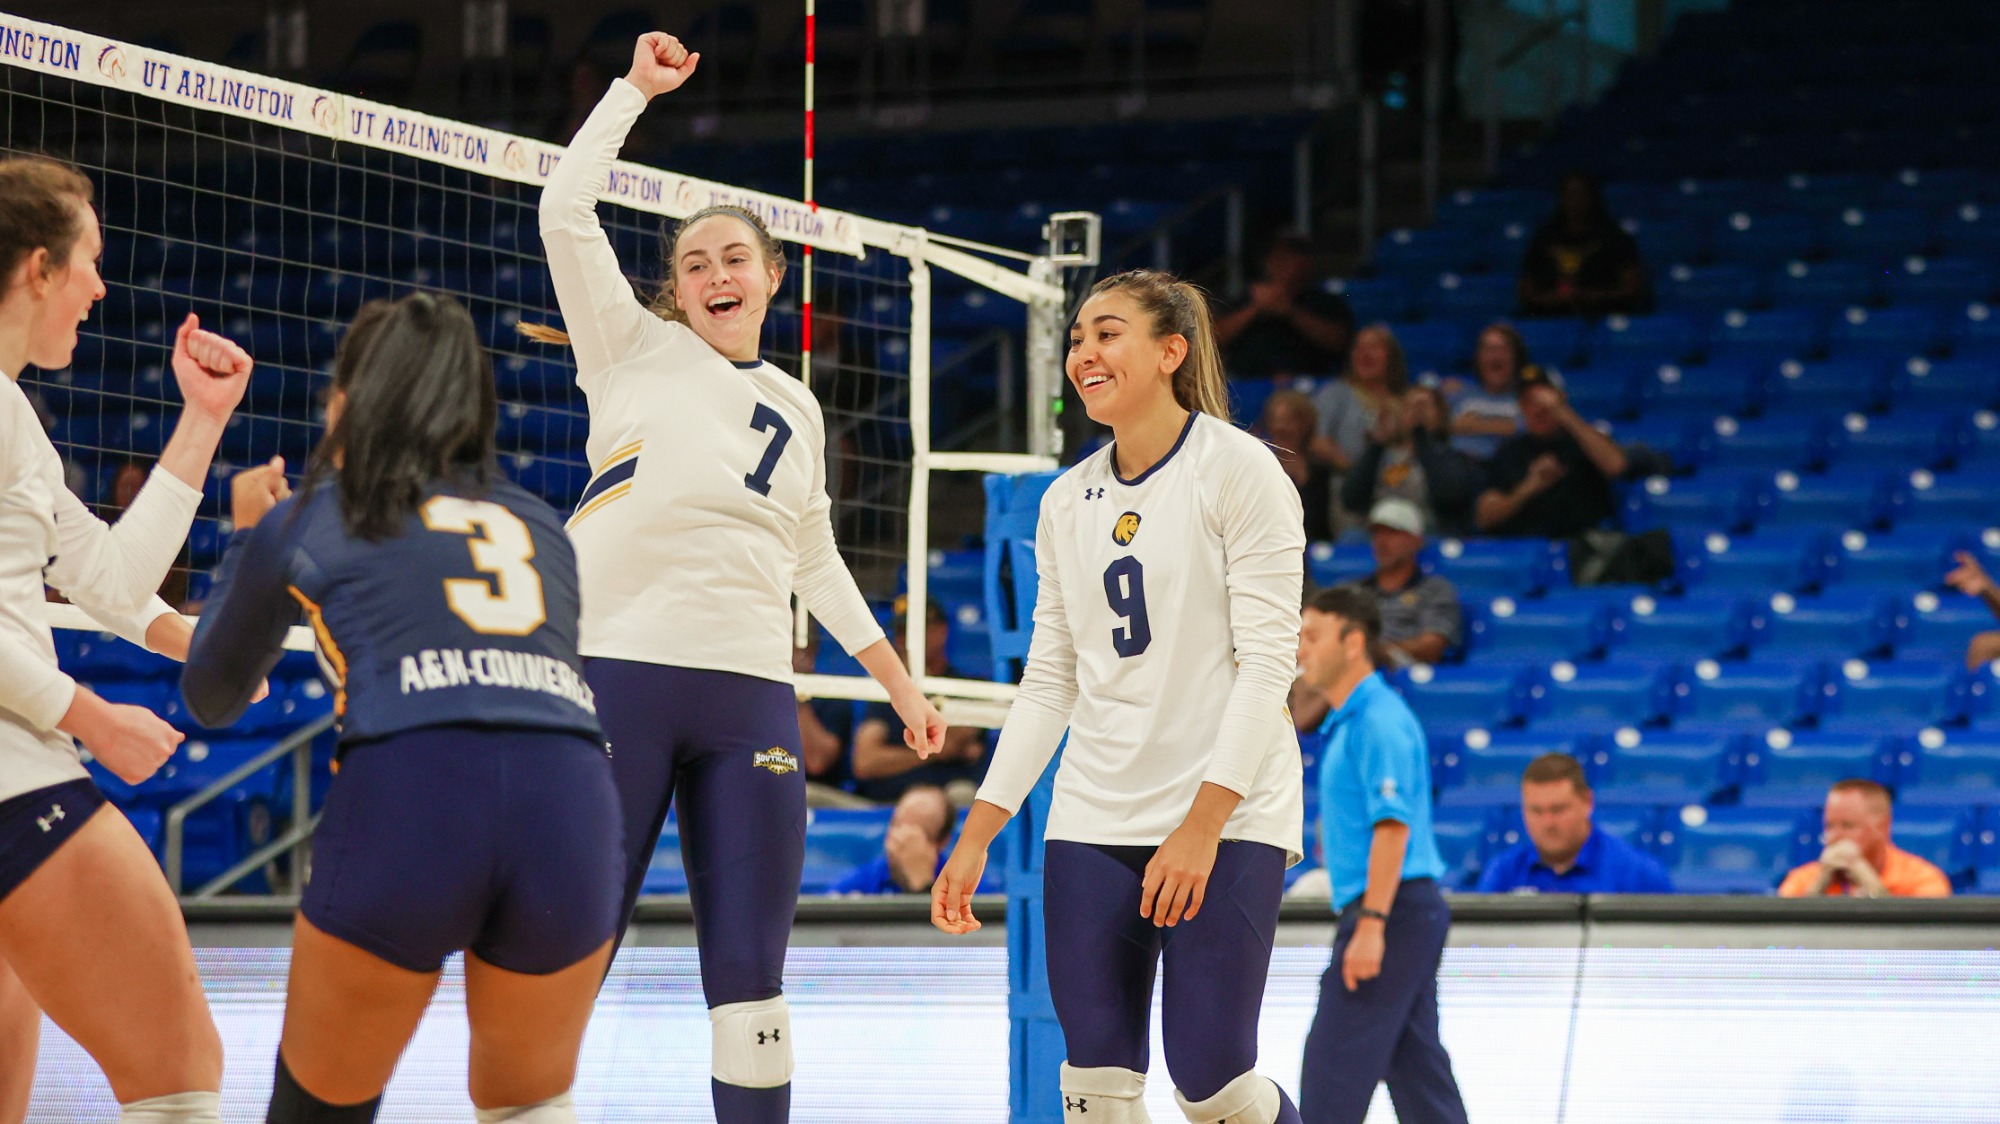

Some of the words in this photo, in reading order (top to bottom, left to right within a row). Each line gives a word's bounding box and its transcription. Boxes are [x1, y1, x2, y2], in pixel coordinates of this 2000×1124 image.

[143, 60, 171, 91] UT
[177, 69, 294, 120] ARLINGTON
[351, 109, 376, 138] UT
[382, 117, 488, 163] ARLINGTON
[745, 402, 793, 498] 7
[419, 495, 546, 636] 3
[1103, 555, 1152, 658] 9
[755, 752, 798, 770] SOUTHLAND
